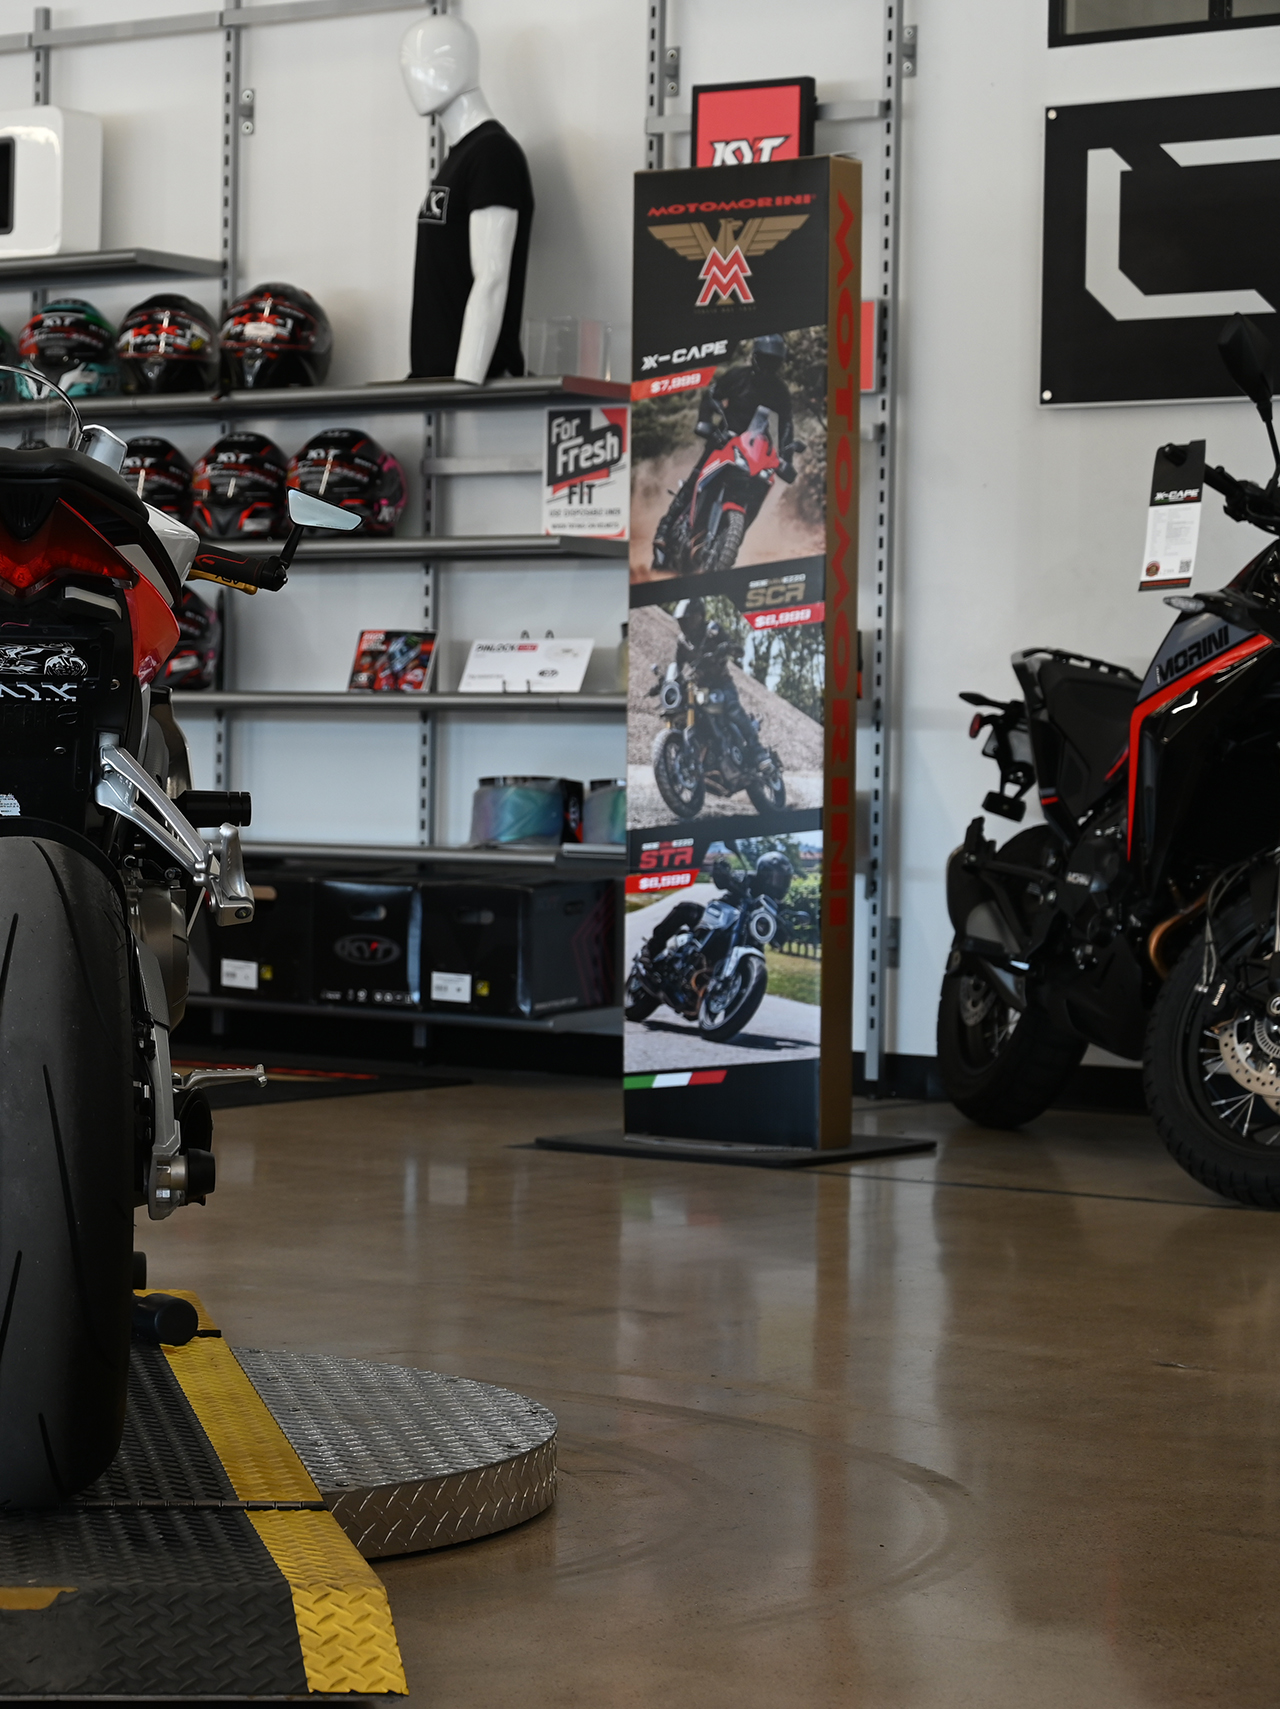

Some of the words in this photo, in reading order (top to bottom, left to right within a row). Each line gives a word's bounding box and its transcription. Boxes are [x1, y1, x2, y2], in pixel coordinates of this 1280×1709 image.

[647, 194, 813, 217] MOTOMORINI
[551, 416, 580, 444] For
[556, 431, 620, 477] Fresh
[568, 483, 595, 505] FIT
[1159, 624, 1230, 682] MORINI
